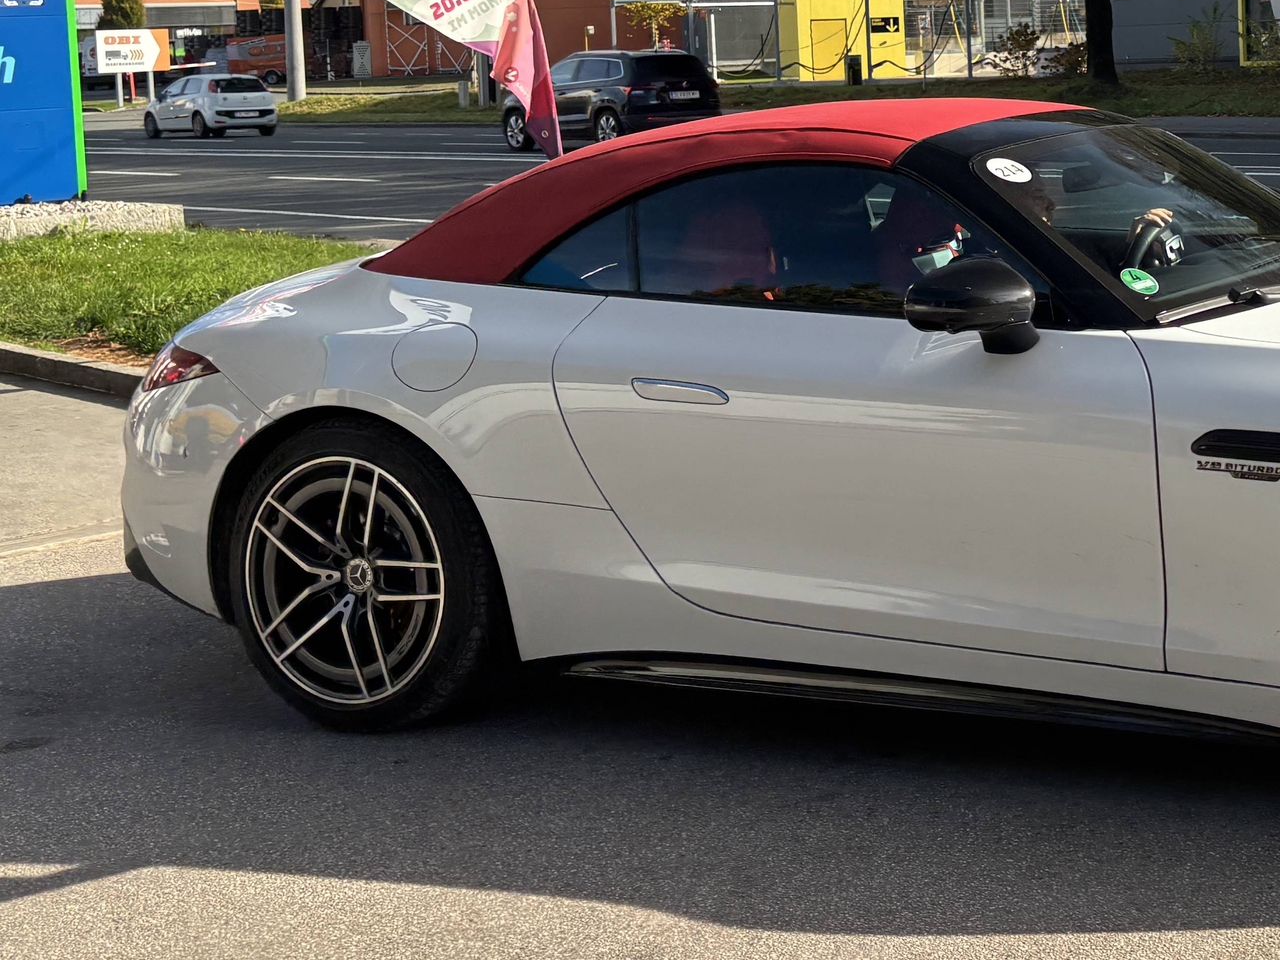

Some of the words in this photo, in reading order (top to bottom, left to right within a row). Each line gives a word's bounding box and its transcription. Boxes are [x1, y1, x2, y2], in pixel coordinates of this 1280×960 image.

[447, 13, 468, 33] IM
[103, 35, 142, 46] OBI
[1128, 270, 1142, 281] 4
